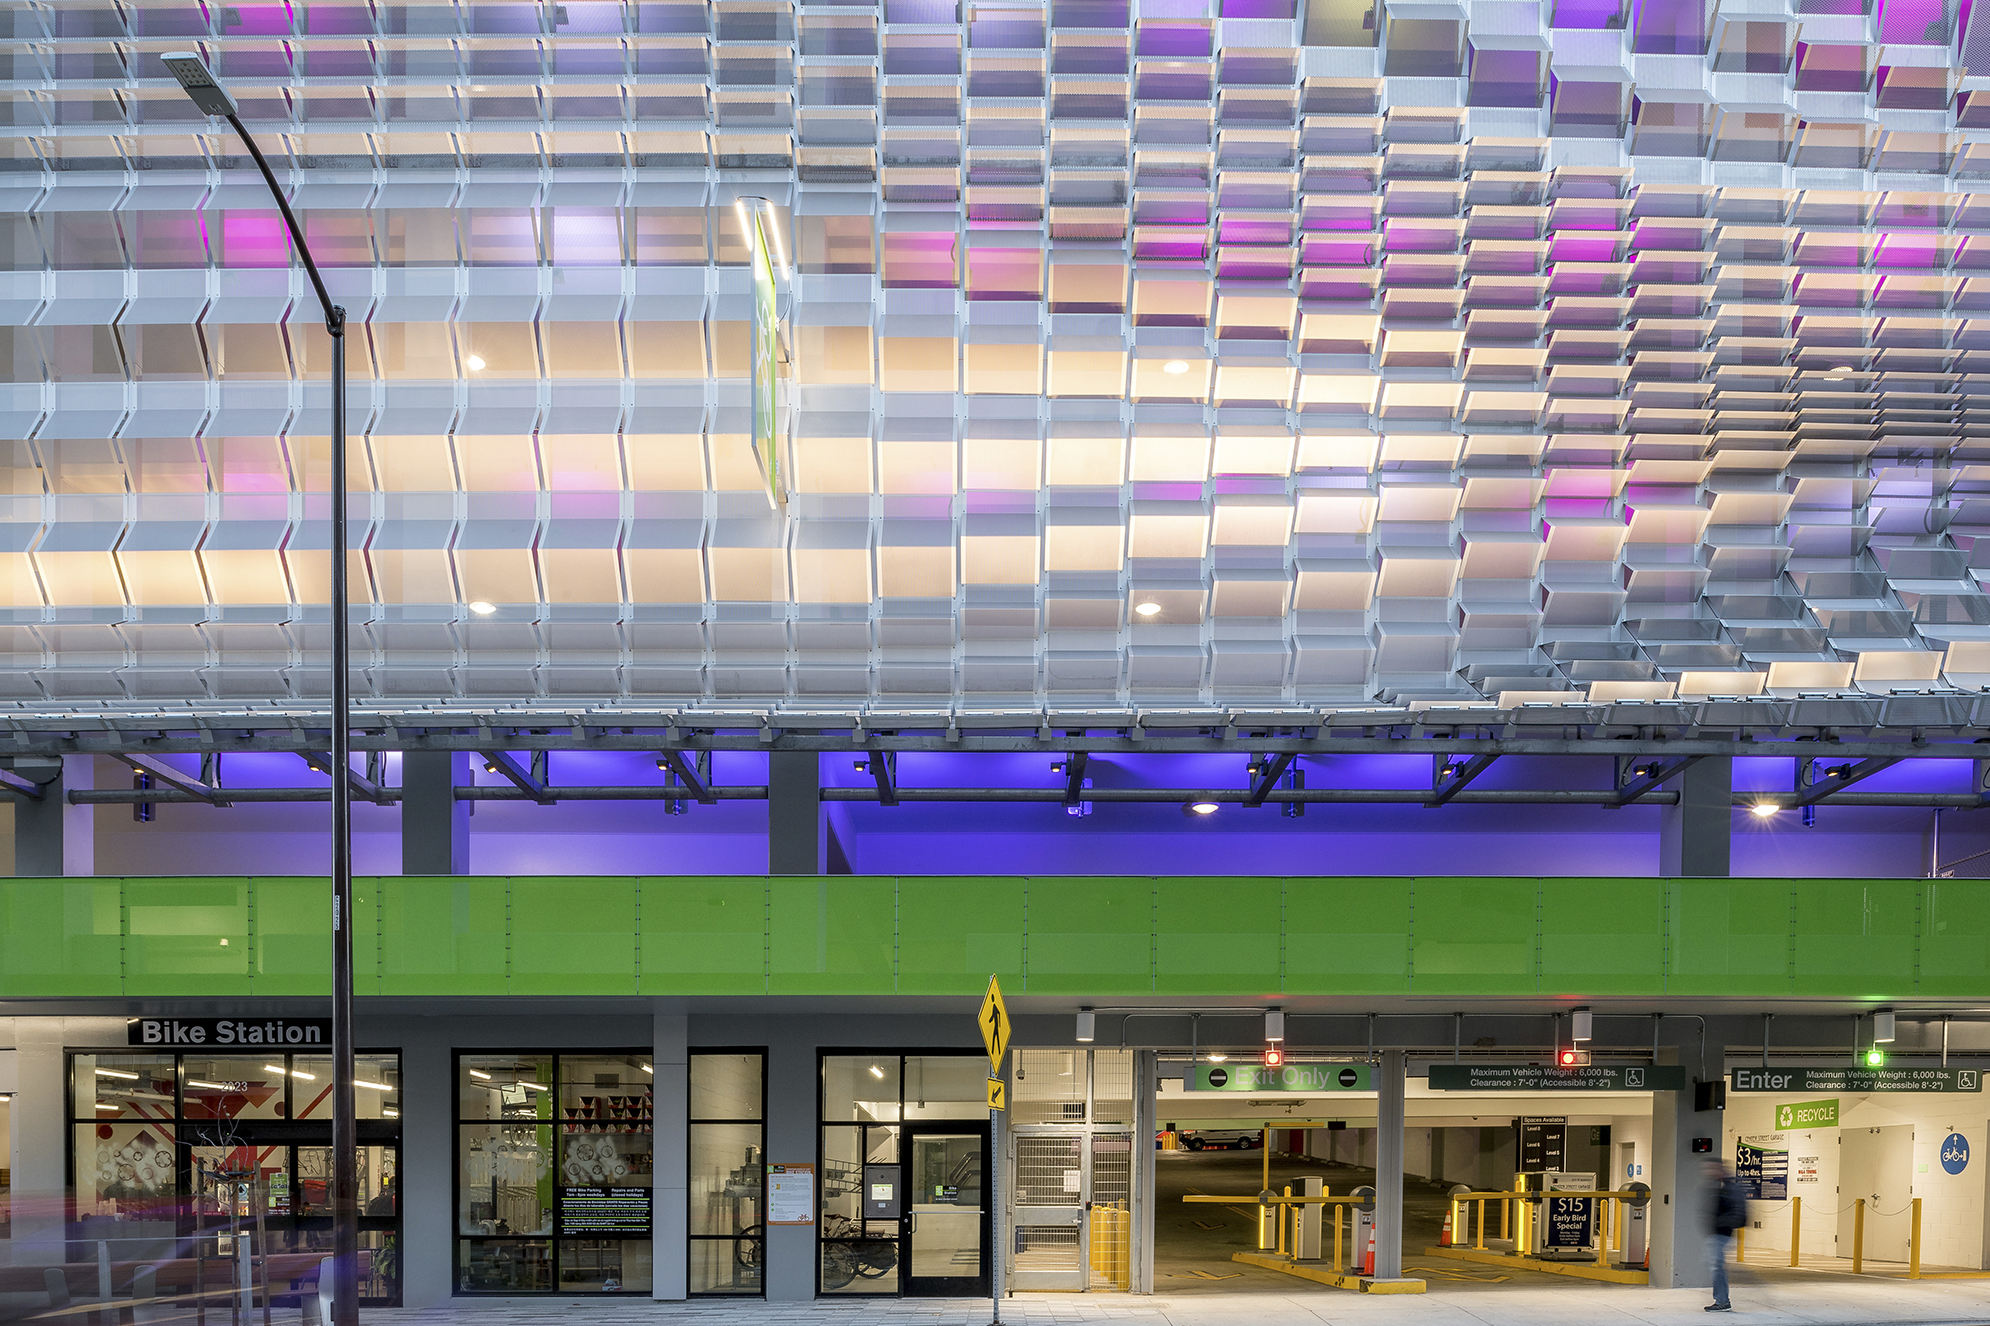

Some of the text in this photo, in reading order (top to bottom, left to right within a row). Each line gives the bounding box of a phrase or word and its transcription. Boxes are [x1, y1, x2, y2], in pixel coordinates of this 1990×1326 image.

[142, 1020, 321, 1043] Bike Station
[1235, 1067, 1330, 1089] Exit Only
[1470, 1068, 1511, 1076] Maximum
[1512, 1068, 1542, 1076] Vehicle
[1544, 1068, 1573, 1078] Weight
[1579, 1068, 1601, 1077] 6,000
[1603, 1068, 1618, 1076] lbs.
[1806, 1070, 1845, 1078] Maximum
[1847, 1070, 1876, 1078] Vehicle
[1878, 1070, 1906, 1080] Weight
[1913, 1071, 1934, 1080] 6,000
[1936, 1071, 1950, 1079] lbs.
[1470, 1078, 1511, 1086] Clearance
[1518, 1078, 1537, 1086] 7'-0"
[1540, 1078, 1587, 1088] (Accessible
[1588, 1078, 1611, 1088] 8'-2")
[1737, 1070, 1792, 1089] Enter
[221, 1081, 248, 1092] 2023
[1806, 1081, 1846, 1089] Clearance
[1853, 1081, 1872, 1089] 7'-0"
[1874, 1081, 1920, 1090] (Accessible
[1921, 1081, 1943, 1090] 8'-2")
[1797, 1107, 1834, 1122] RECYCLE
[1558, 1198, 1583, 1213] $15
[1553, 1214, 1571, 1223] Early
